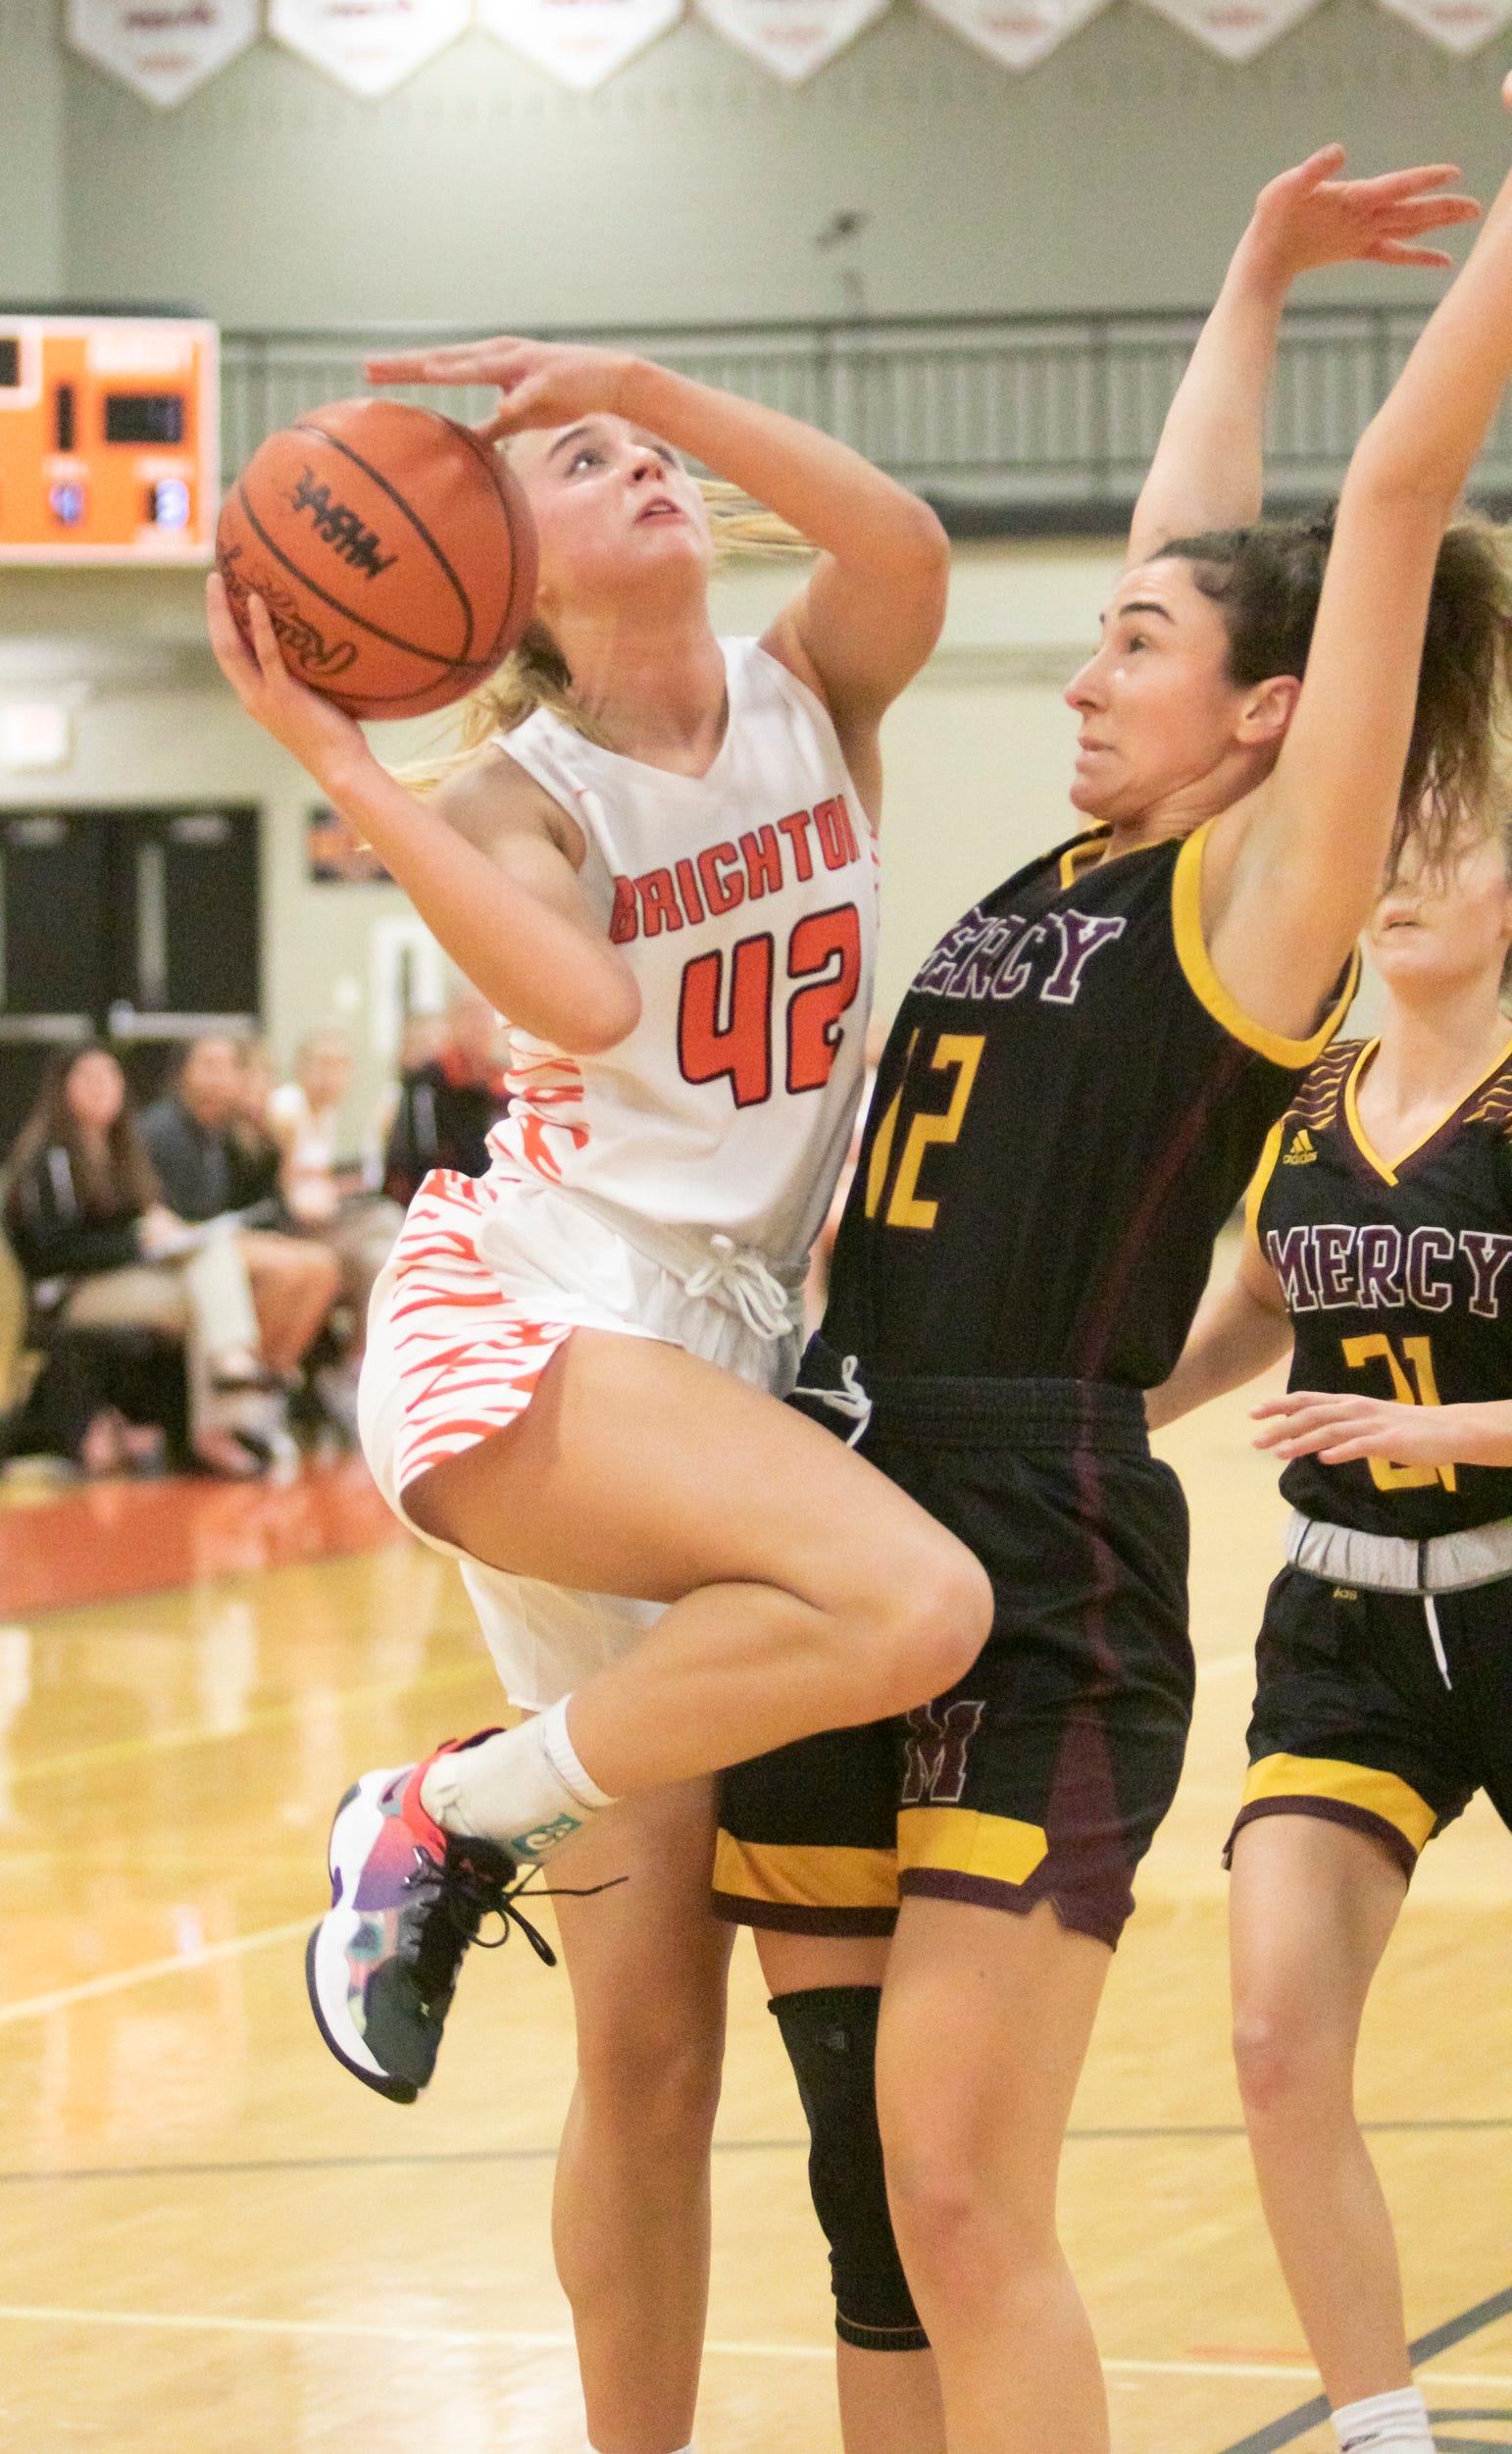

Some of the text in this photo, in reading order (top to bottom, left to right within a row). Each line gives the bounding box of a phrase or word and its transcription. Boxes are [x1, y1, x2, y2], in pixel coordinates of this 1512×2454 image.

[677, 901, 861, 1108] 42
[911, 906, 1127, 1003] ERCY
[1267, 1224, 1512, 1318] MERCY
[1340, 1334, 1456, 1492] 21
